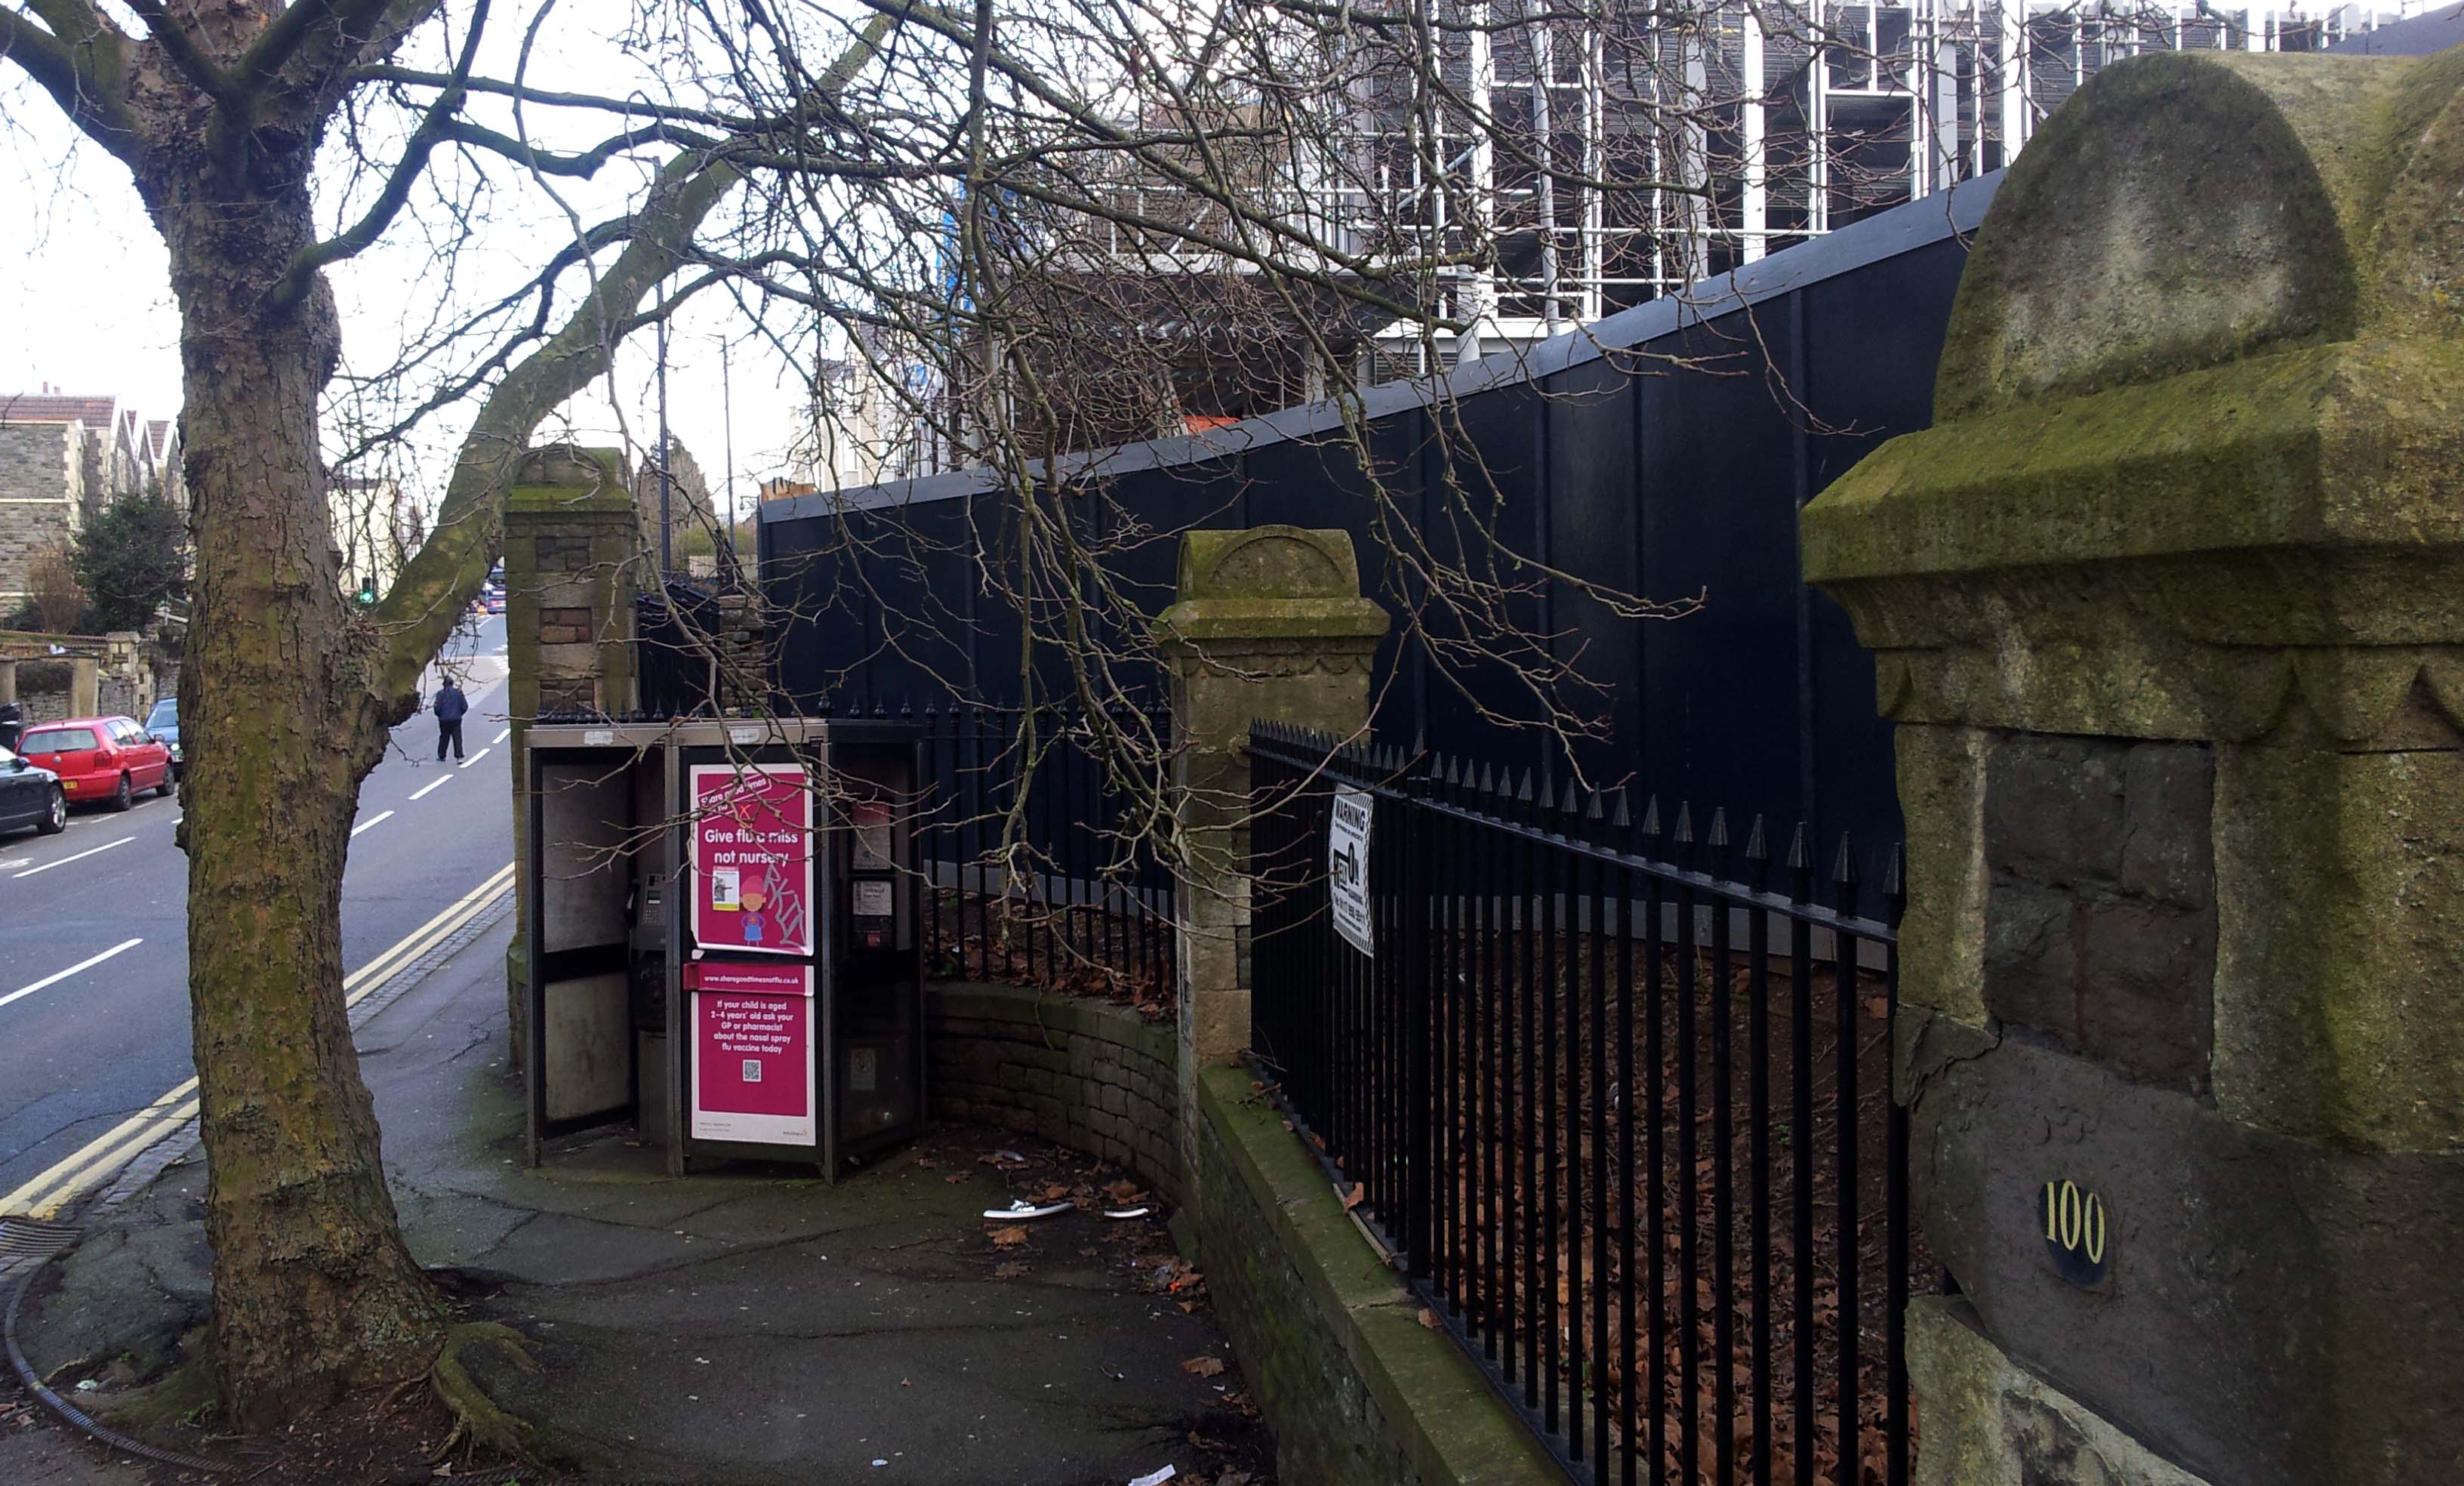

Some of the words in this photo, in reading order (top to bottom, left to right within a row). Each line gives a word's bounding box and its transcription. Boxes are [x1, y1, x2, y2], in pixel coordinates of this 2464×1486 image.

[1335, 797, 1366, 832] WARNING
[705, 829, 734, 843] Give
[736, 829, 753, 843] flu
[756, 832, 765, 843] a
[768, 829, 798, 843] miss
[714, 850, 736, 863] not
[740, 852, 789, 868] nursery
[717, 999, 723, 1007] If
[724, 1001, 740, 1010] your
[741, 1000, 759, 1009] child
[768, 1002, 787, 1011] aged
[778, 1014, 794, 1022] your
[743, 1022, 783, 1032] pharmacist
[771, 1035, 791, 1044] spray
[733, 1044, 759, 1052] vaccine
[761, 1044, 782, 1055] today
[2047, 1180, 2105, 1264] 100
